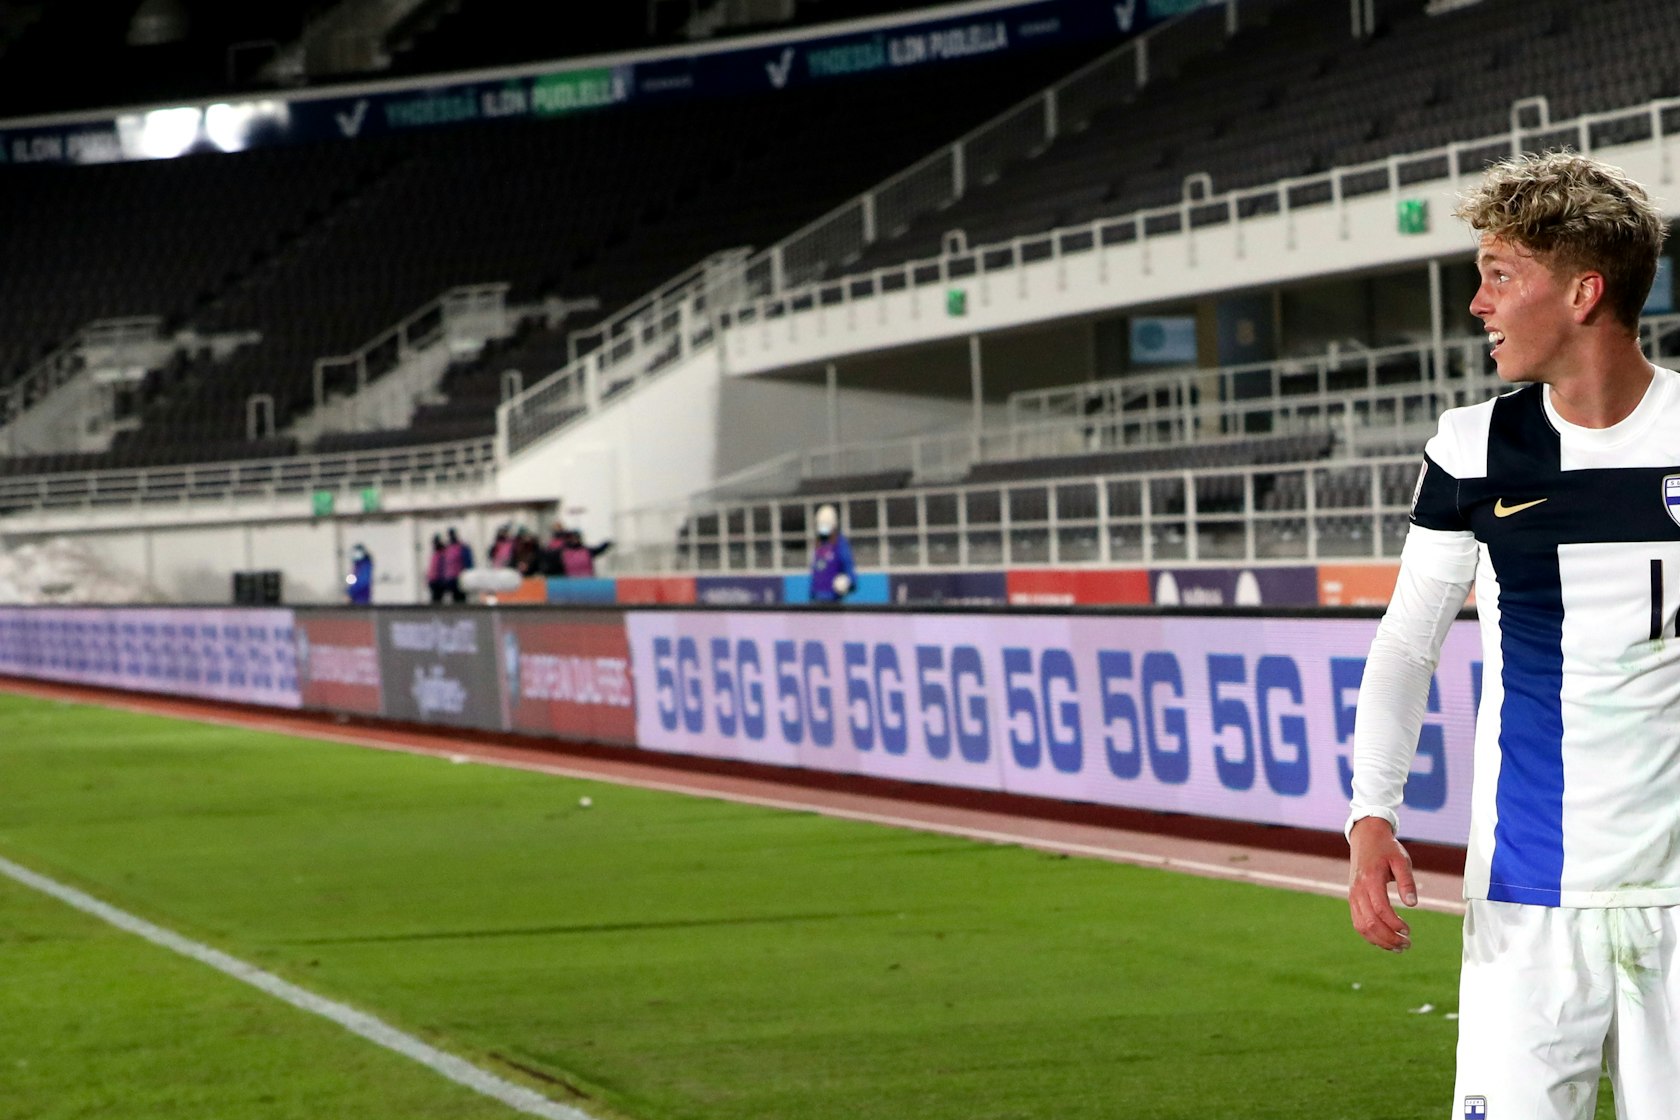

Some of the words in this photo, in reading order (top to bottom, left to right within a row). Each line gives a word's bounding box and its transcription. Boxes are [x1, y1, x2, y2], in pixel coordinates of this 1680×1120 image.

[653, 636, 704, 734] 5G
[711, 638, 765, 740] 5G
[774, 639, 834, 746] 5G
[844, 642, 906, 755] 5G
[916, 646, 989, 763] 5G
[1002, 647, 1083, 774] 5G
[1098, 650, 1190, 785] 5G
[1206, 653, 1310, 796] 5G
